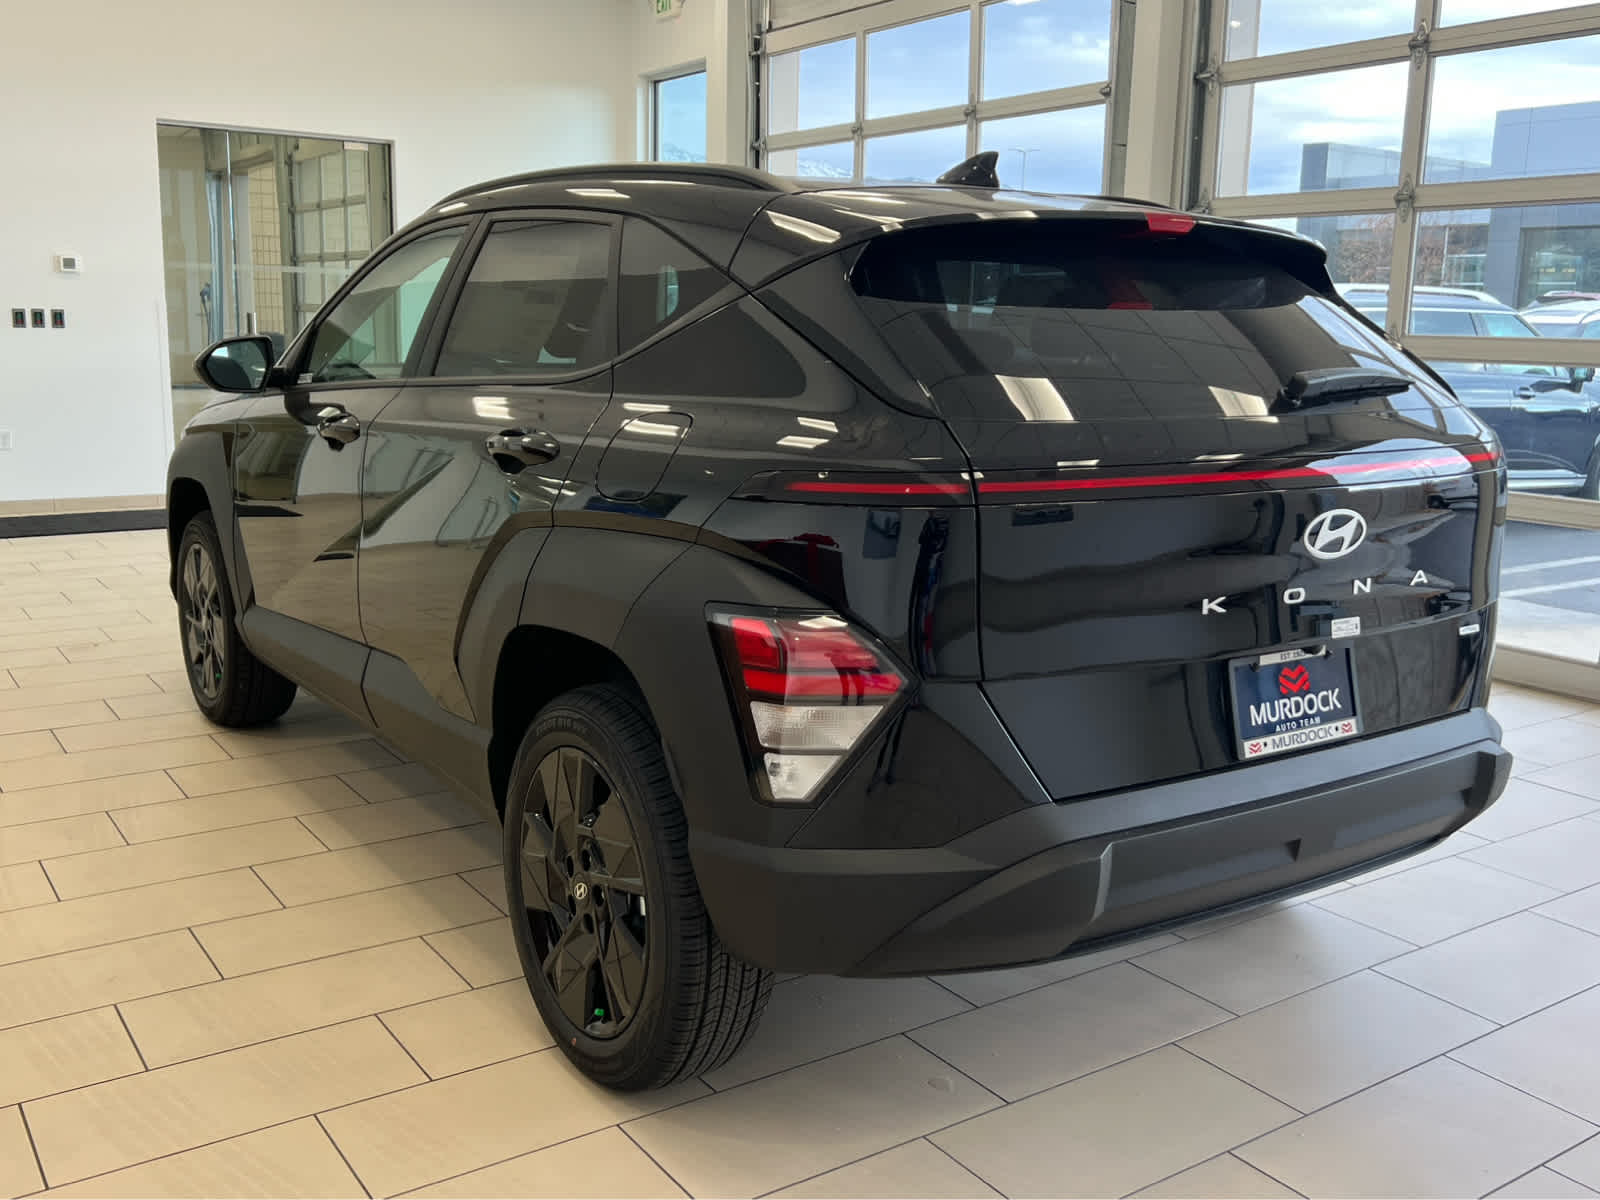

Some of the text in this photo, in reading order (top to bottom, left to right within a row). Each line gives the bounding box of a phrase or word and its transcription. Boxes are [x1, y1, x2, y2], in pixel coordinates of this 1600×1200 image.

[1249, 688, 1342, 726] MURDOCK
[1275, 716, 1321, 732] AUTO TEAM
[1272, 726, 1334, 750] MURDOCK
